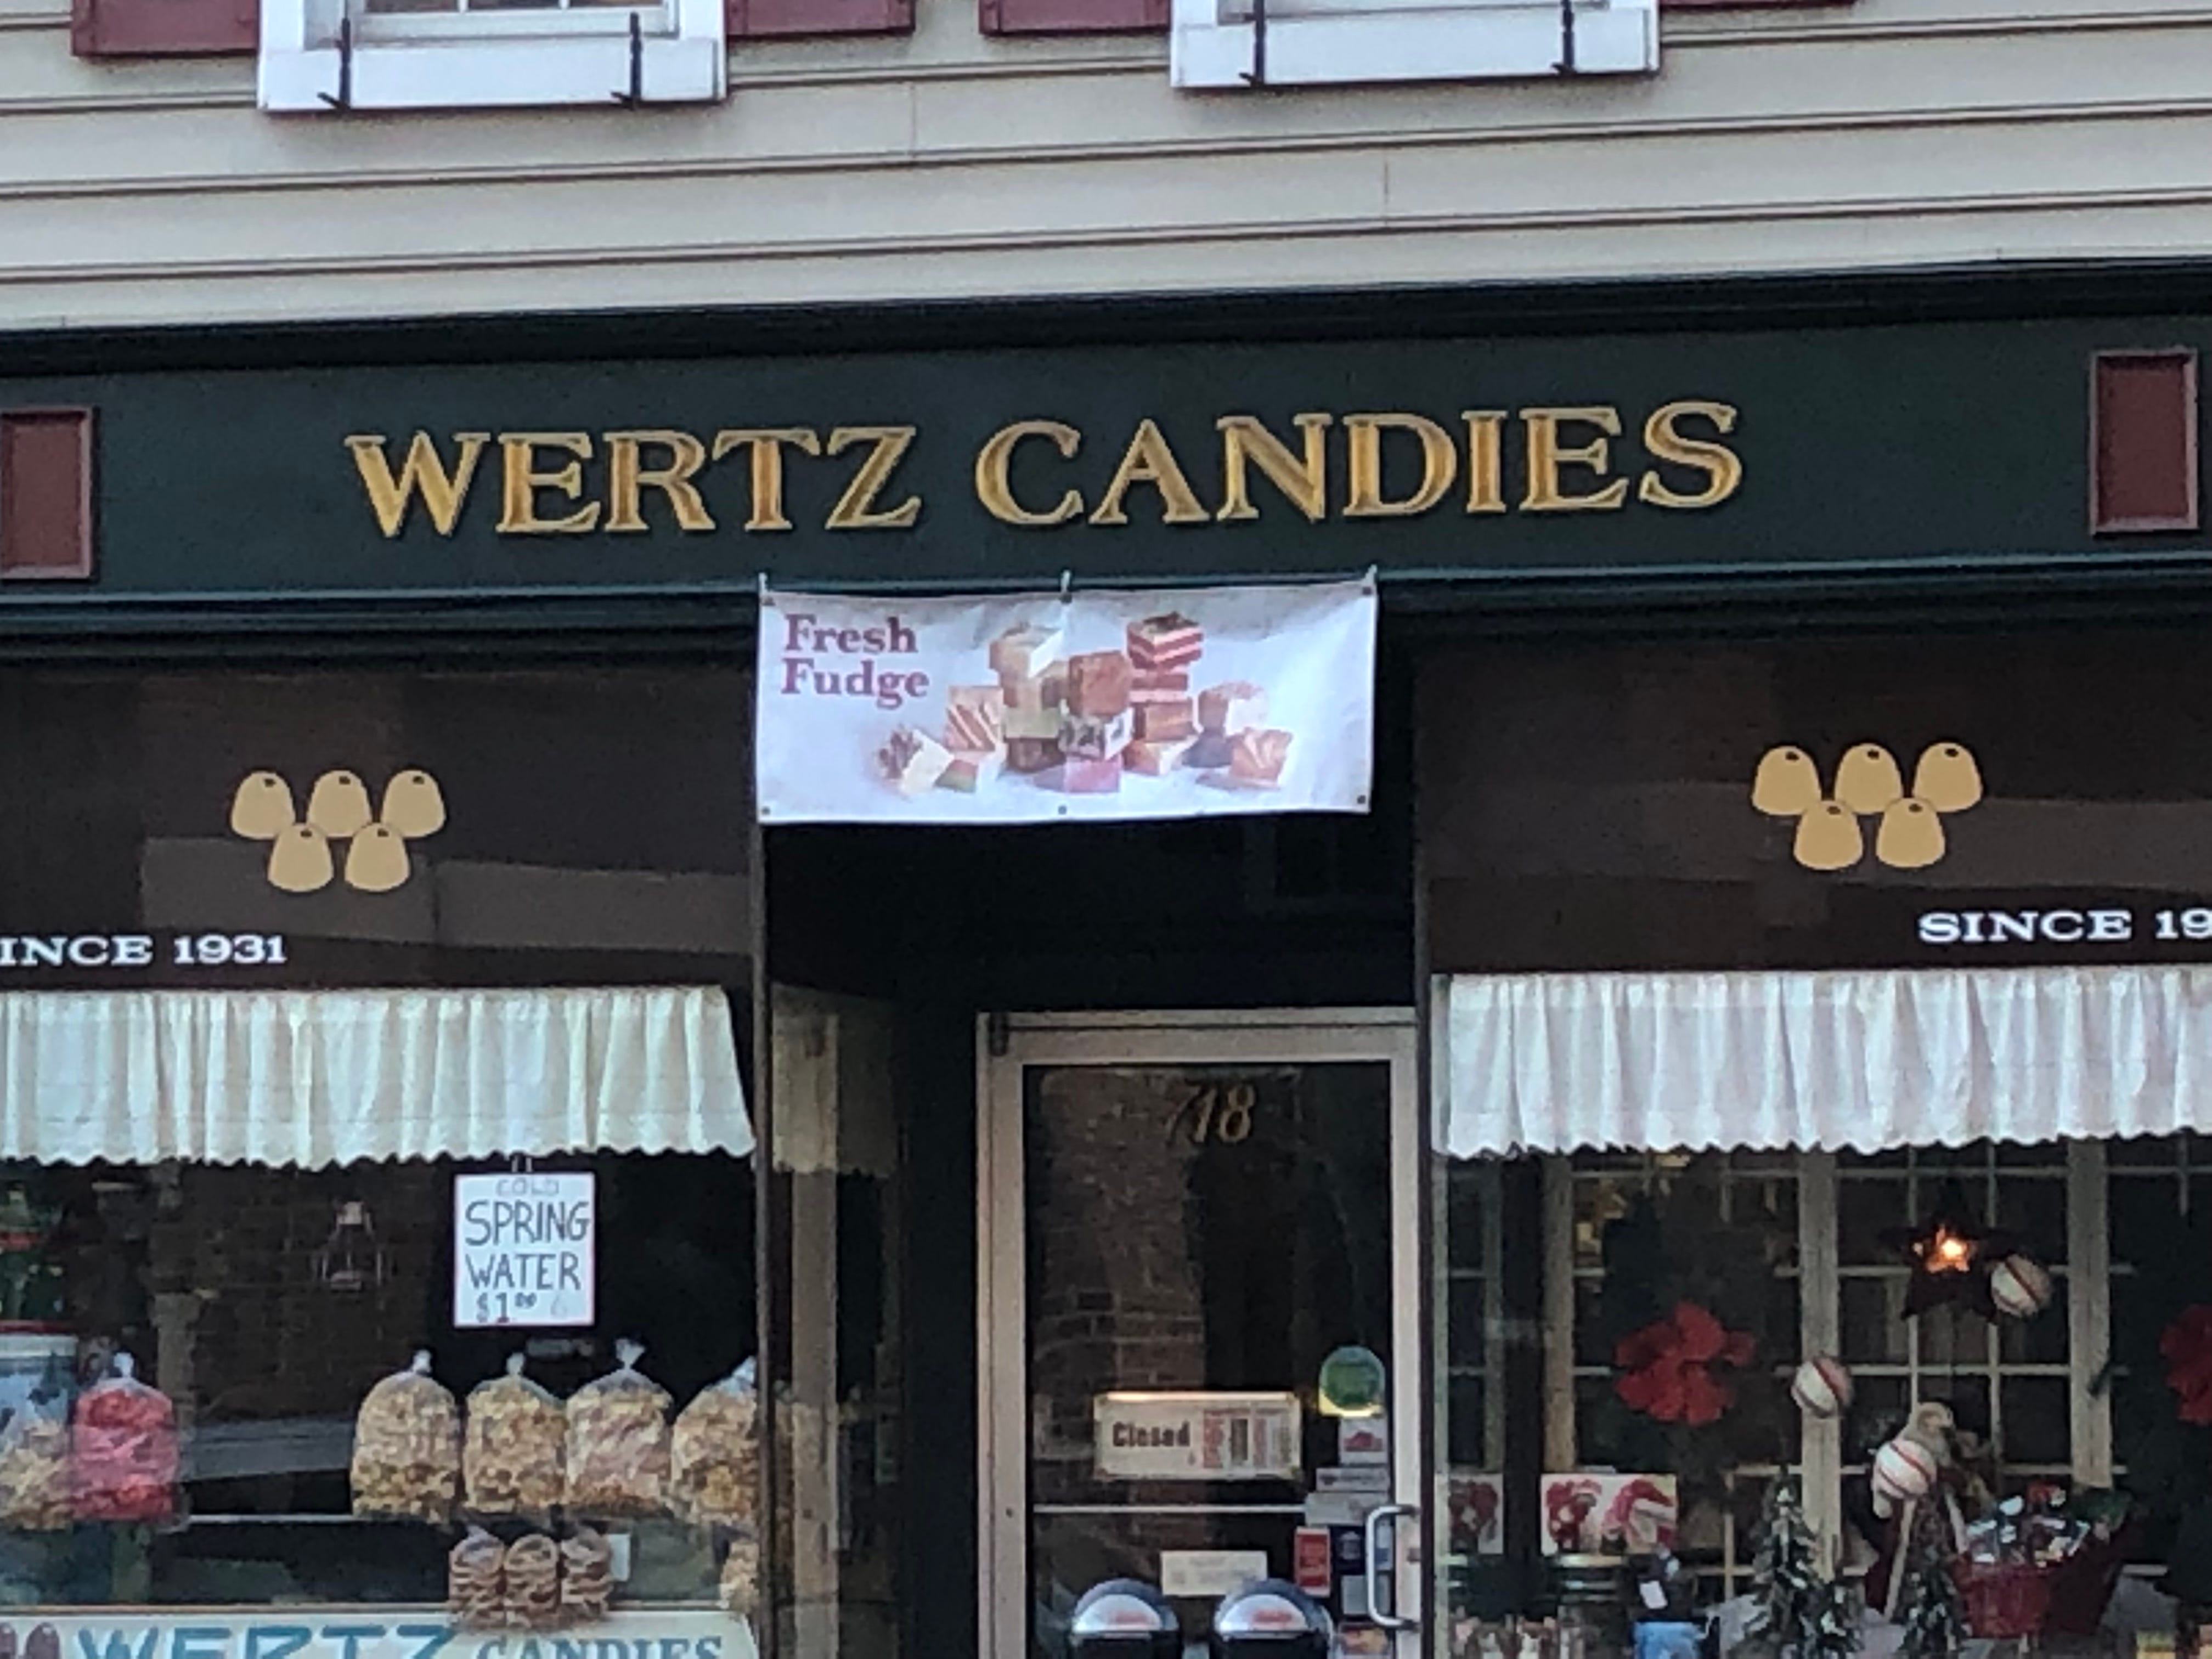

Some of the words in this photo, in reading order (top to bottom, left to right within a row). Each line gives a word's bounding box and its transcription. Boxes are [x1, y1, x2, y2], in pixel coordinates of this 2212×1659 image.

[344, 426, 922, 537] WERTZ
[974, 401, 1743, 525] CANDIES
[784, 614, 919, 654] Fresh
[781, 658, 930, 710] Fudge
[1918, 910, 2132, 943] SINCE
[173, 934, 287, 964] 1931
[465, 1199, 590, 1246] SPRING
[465, 1251, 582, 1290] WATER
[1113, 1420, 1191, 1447] Closed
